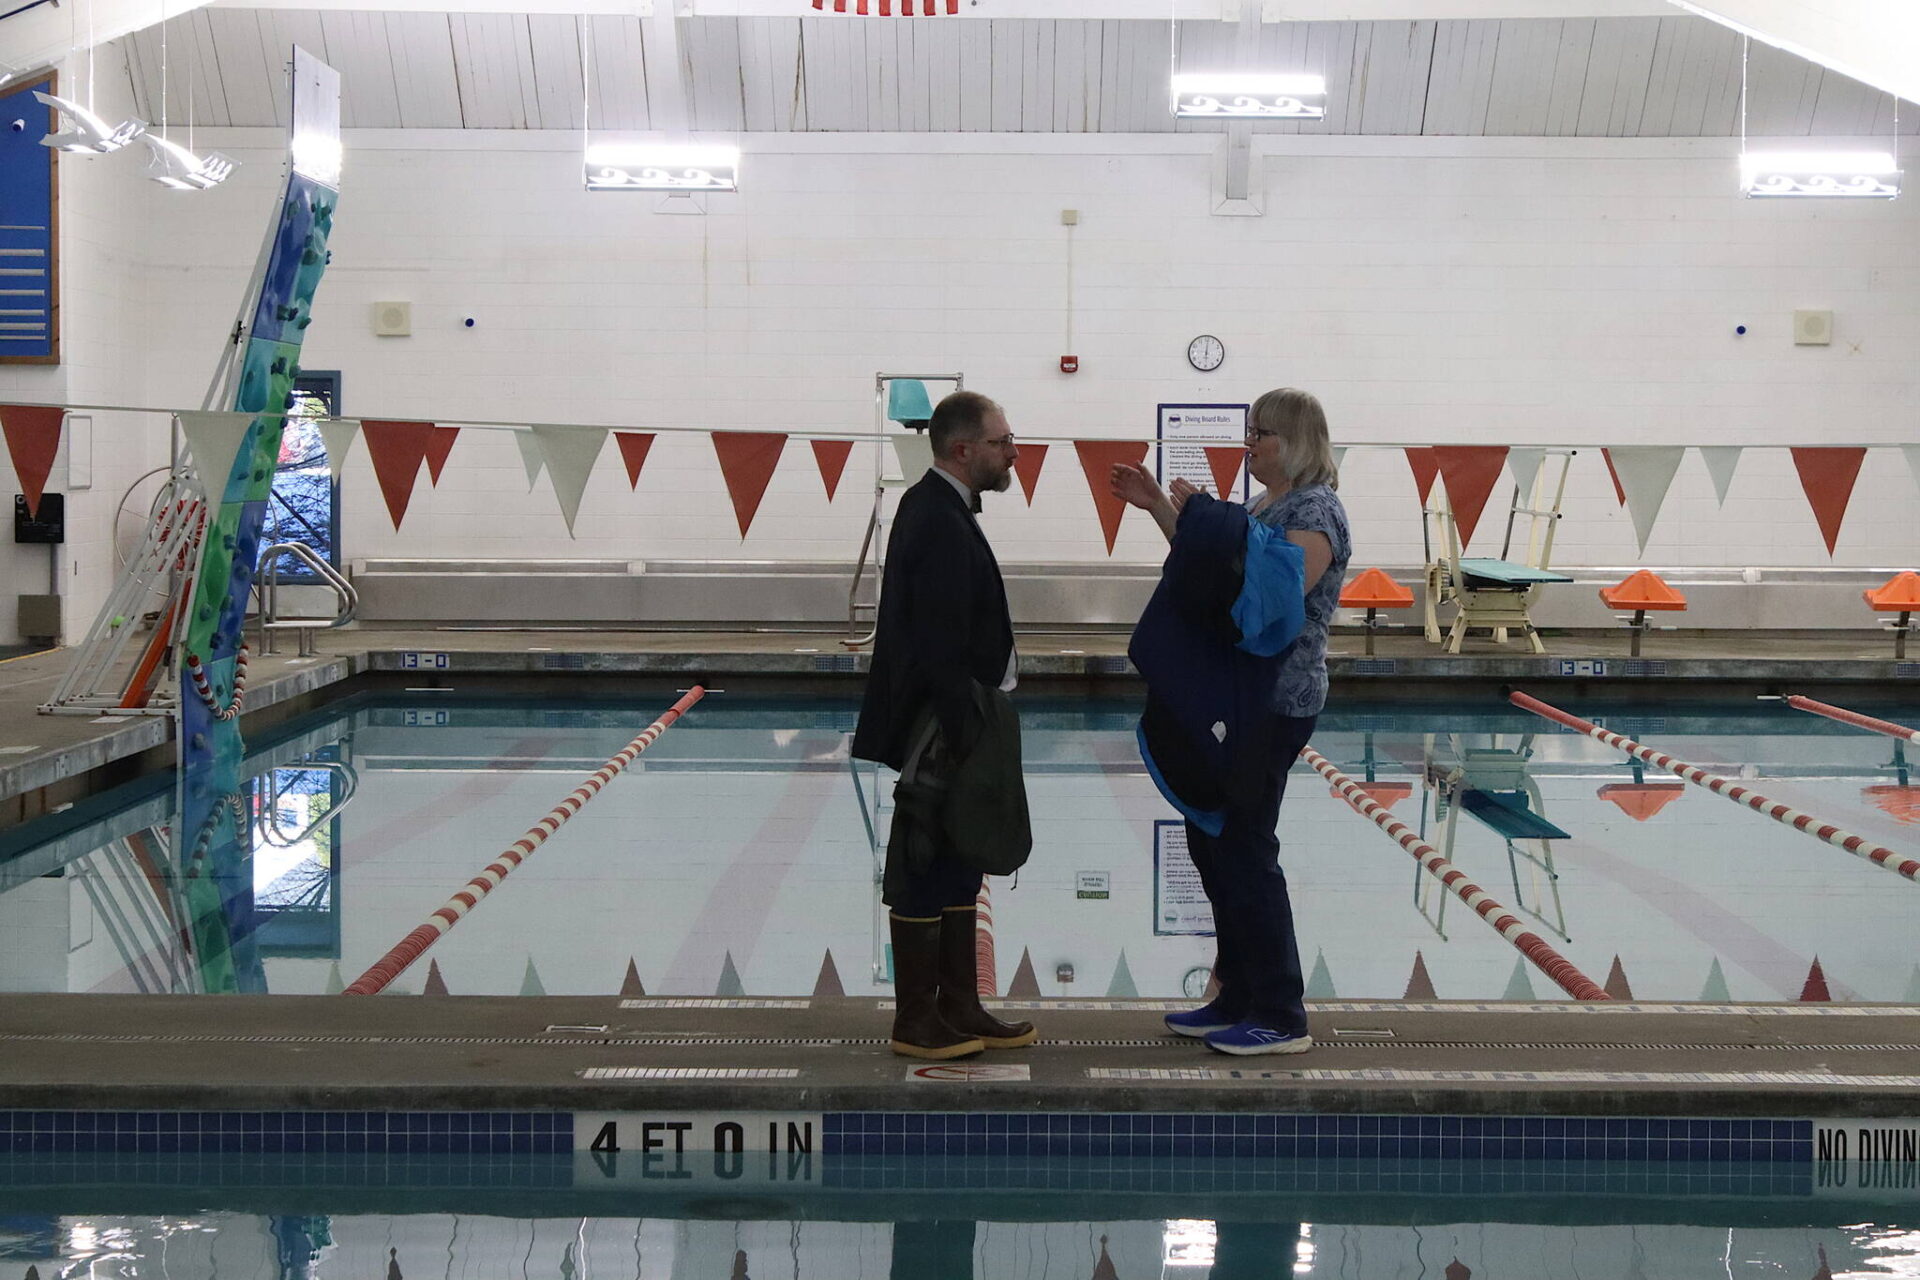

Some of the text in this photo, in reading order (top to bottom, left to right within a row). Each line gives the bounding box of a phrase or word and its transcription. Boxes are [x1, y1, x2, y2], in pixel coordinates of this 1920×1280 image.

[590, 1122, 620, 1152] 4
[643, 1122, 692, 1152] FT
[770, 1122, 811, 1153] IN
[1819, 1129, 1920, 1161] NO DIVIN
